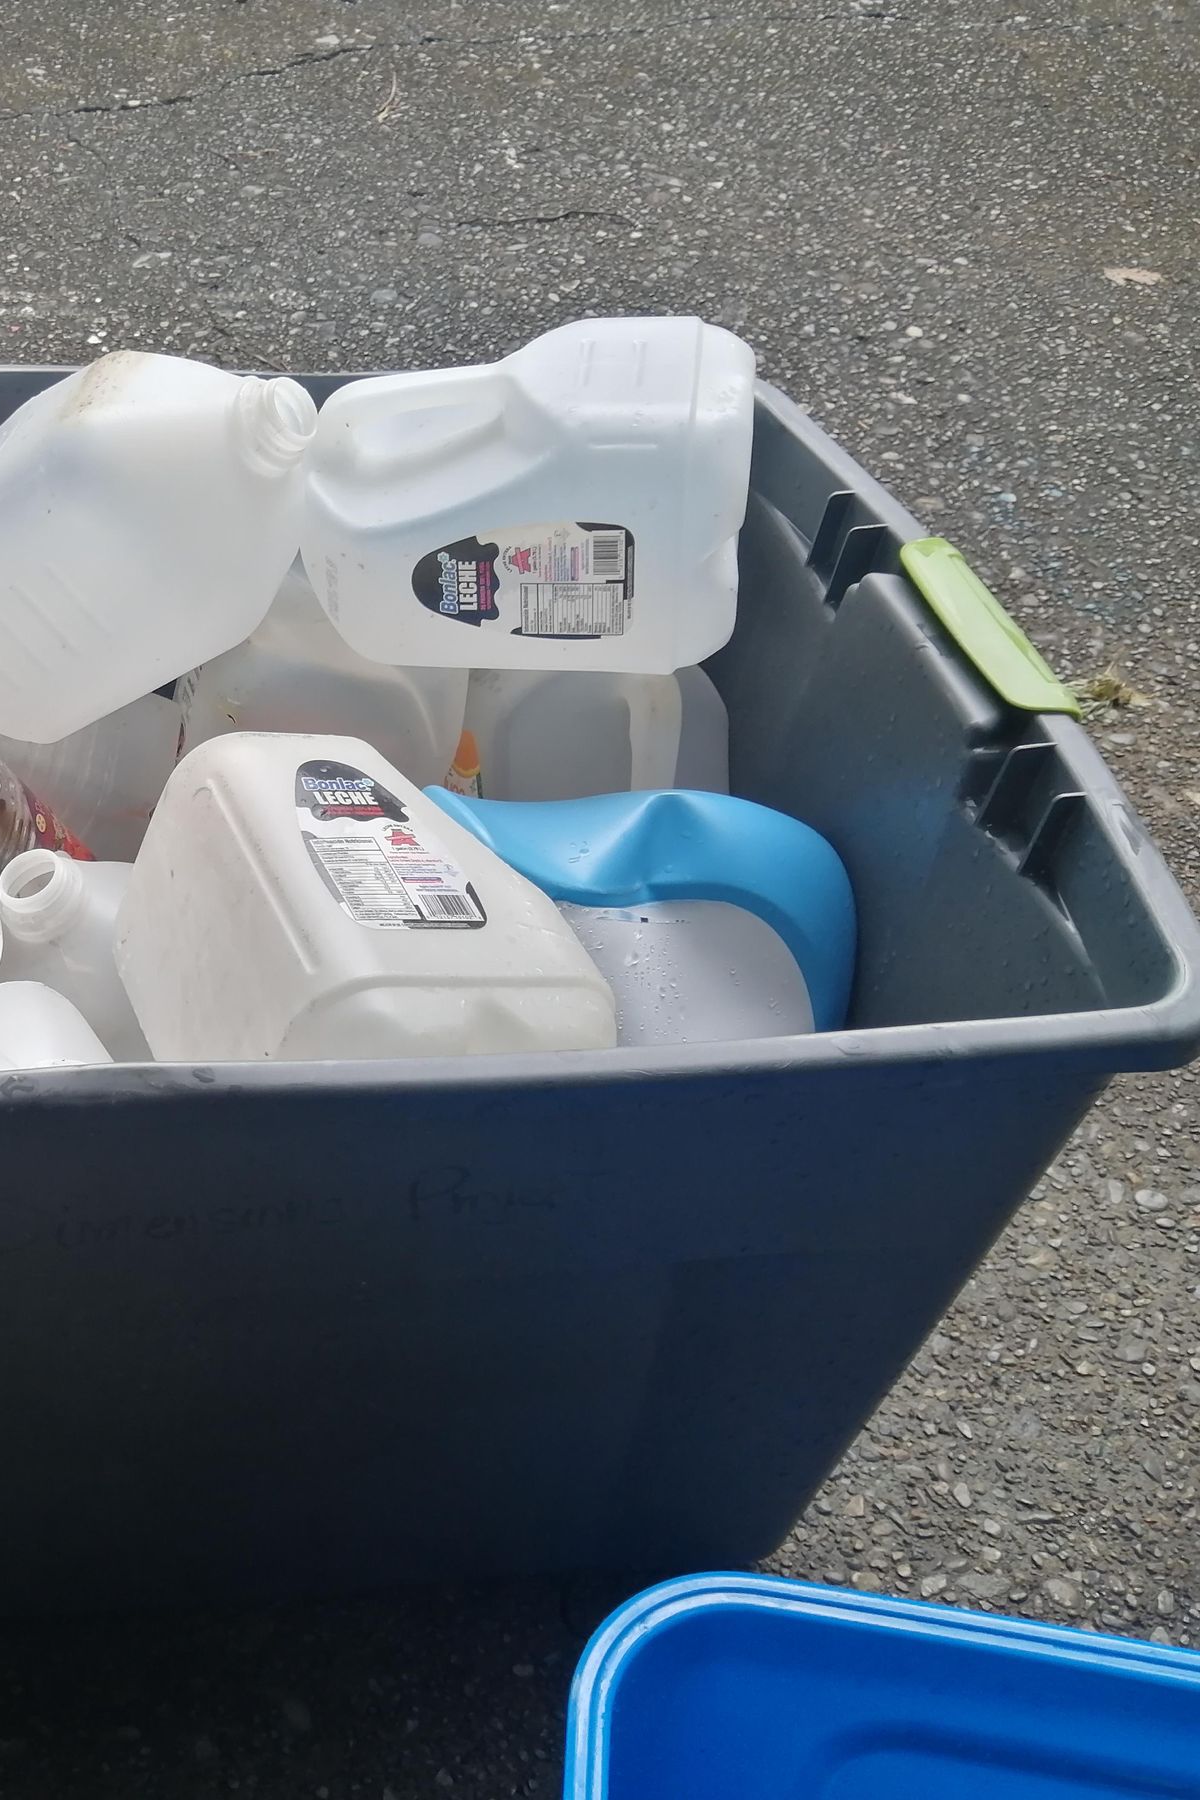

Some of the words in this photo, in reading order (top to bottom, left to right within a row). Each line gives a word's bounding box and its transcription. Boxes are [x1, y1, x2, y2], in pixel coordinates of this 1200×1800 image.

[439, 559, 458, 614] Bonlac
[459, 560, 478, 611] LECHE
[302, 777, 368, 791] Bonlac
[313, 791, 378, 805] LECHE
